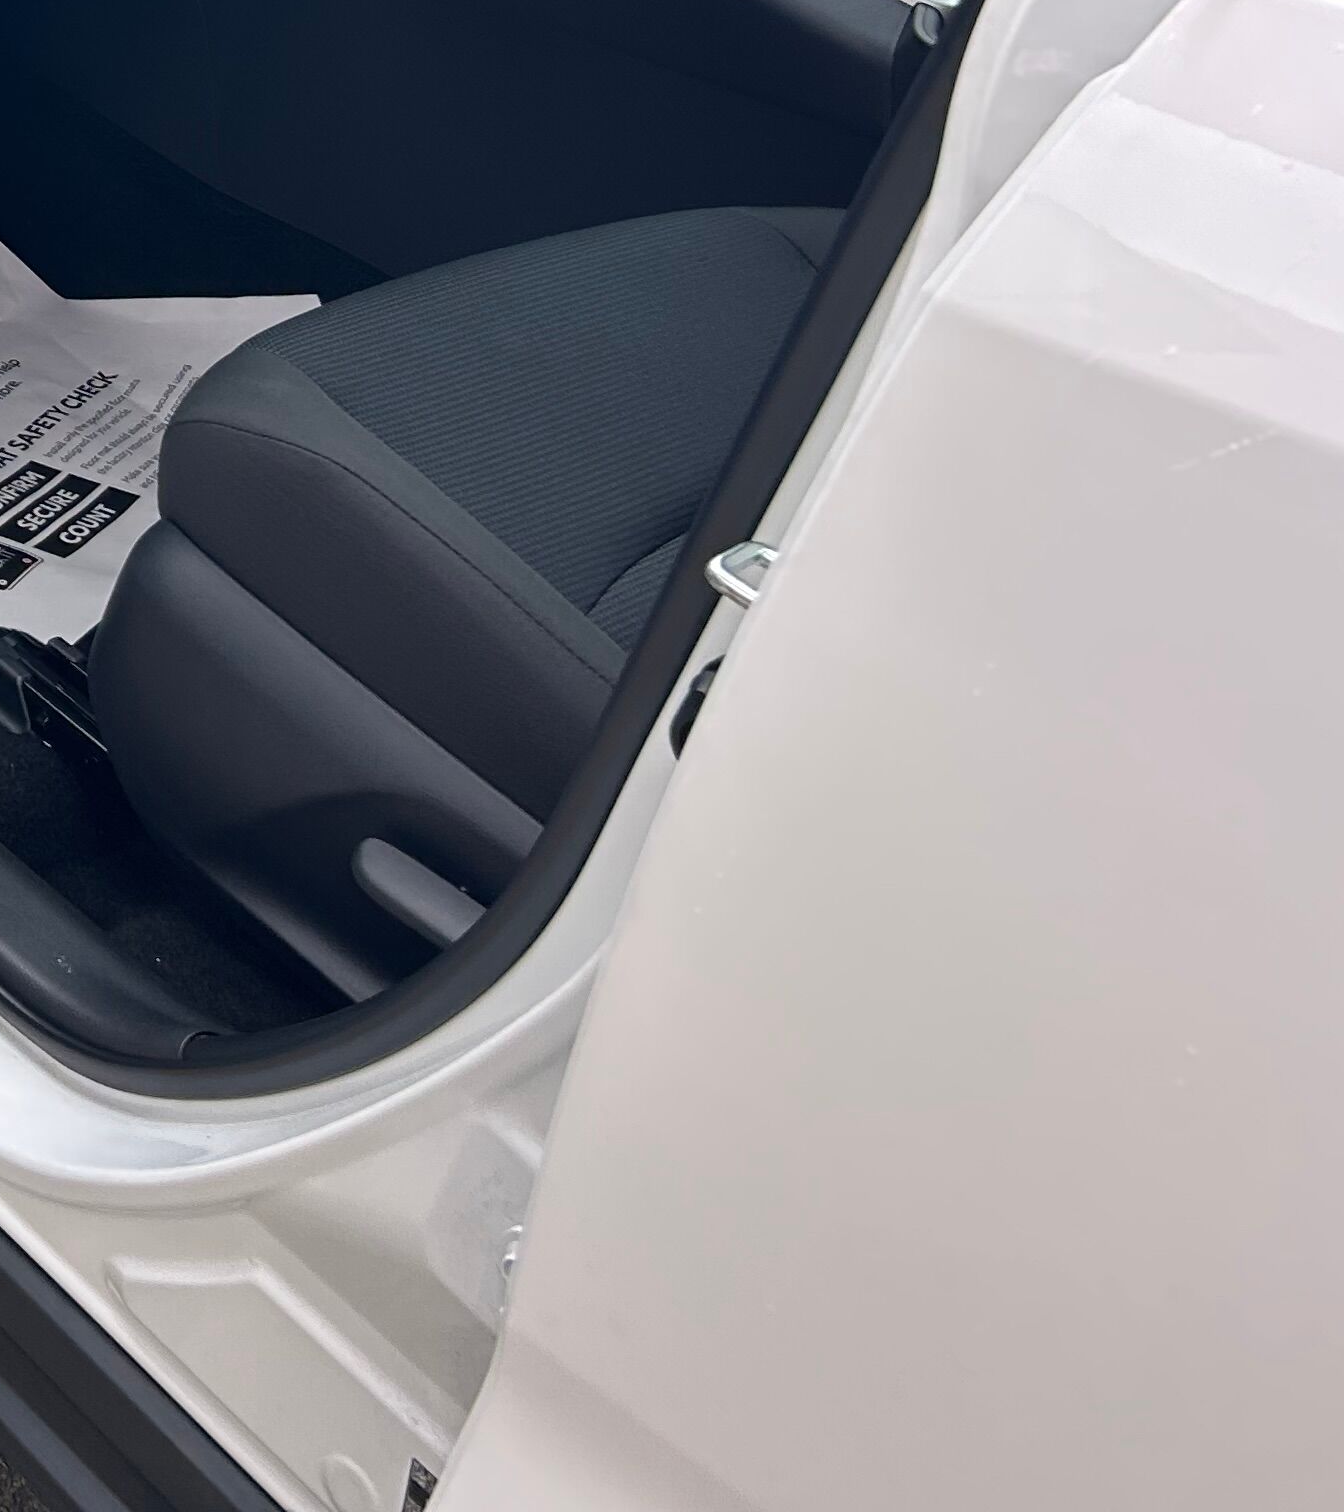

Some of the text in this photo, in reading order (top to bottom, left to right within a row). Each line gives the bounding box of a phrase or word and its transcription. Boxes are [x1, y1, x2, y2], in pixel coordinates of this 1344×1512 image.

[7, 405, 70, 452] SAFETY
[59, 370, 120, 410] CHECK
[16, 488, 80, 532] SECURE
[58, 503, 118, 545] COUNT
